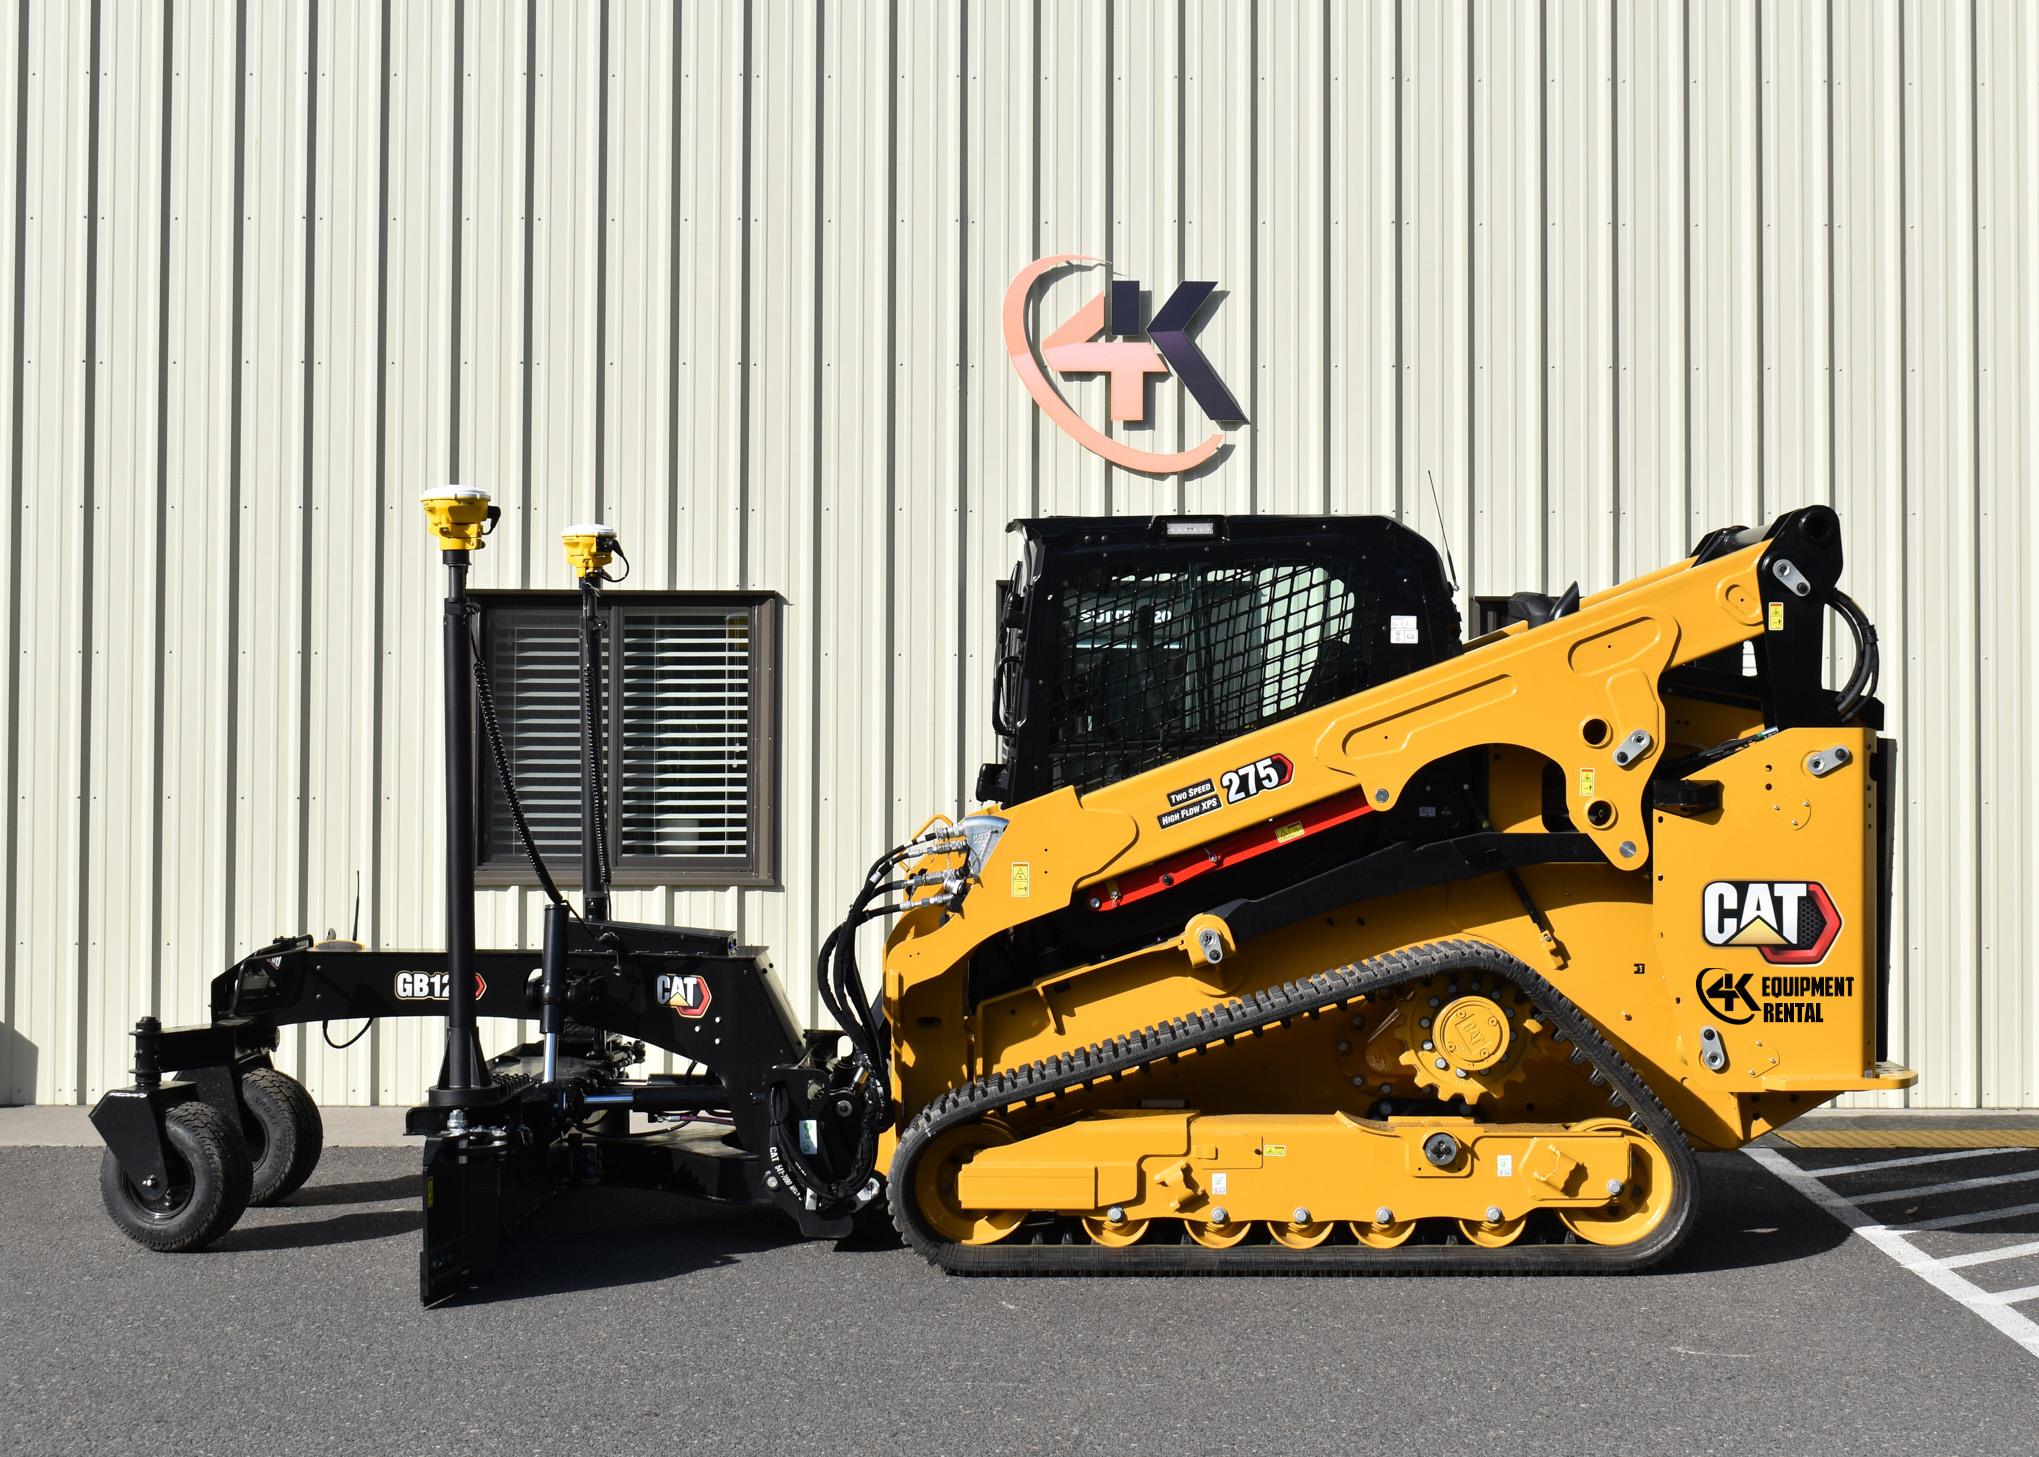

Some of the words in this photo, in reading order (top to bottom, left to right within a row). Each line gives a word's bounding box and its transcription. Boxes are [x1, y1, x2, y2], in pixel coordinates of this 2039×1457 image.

[1041, 280, 1248, 421] 4K
[1221, 758, 1279, 803] 275
[1200, 797, 1218, 811] XPS
[1704, 882, 1807, 945] CAT
[657, 974, 697, 1007] CAT
[1762, 976, 1854, 998] EQUIPMENT
[1763, 1002, 1824, 1023] RENTAL
[1461, 1020, 1485, 1046] CAT
[769, 1146, 780, 1162] CAT
